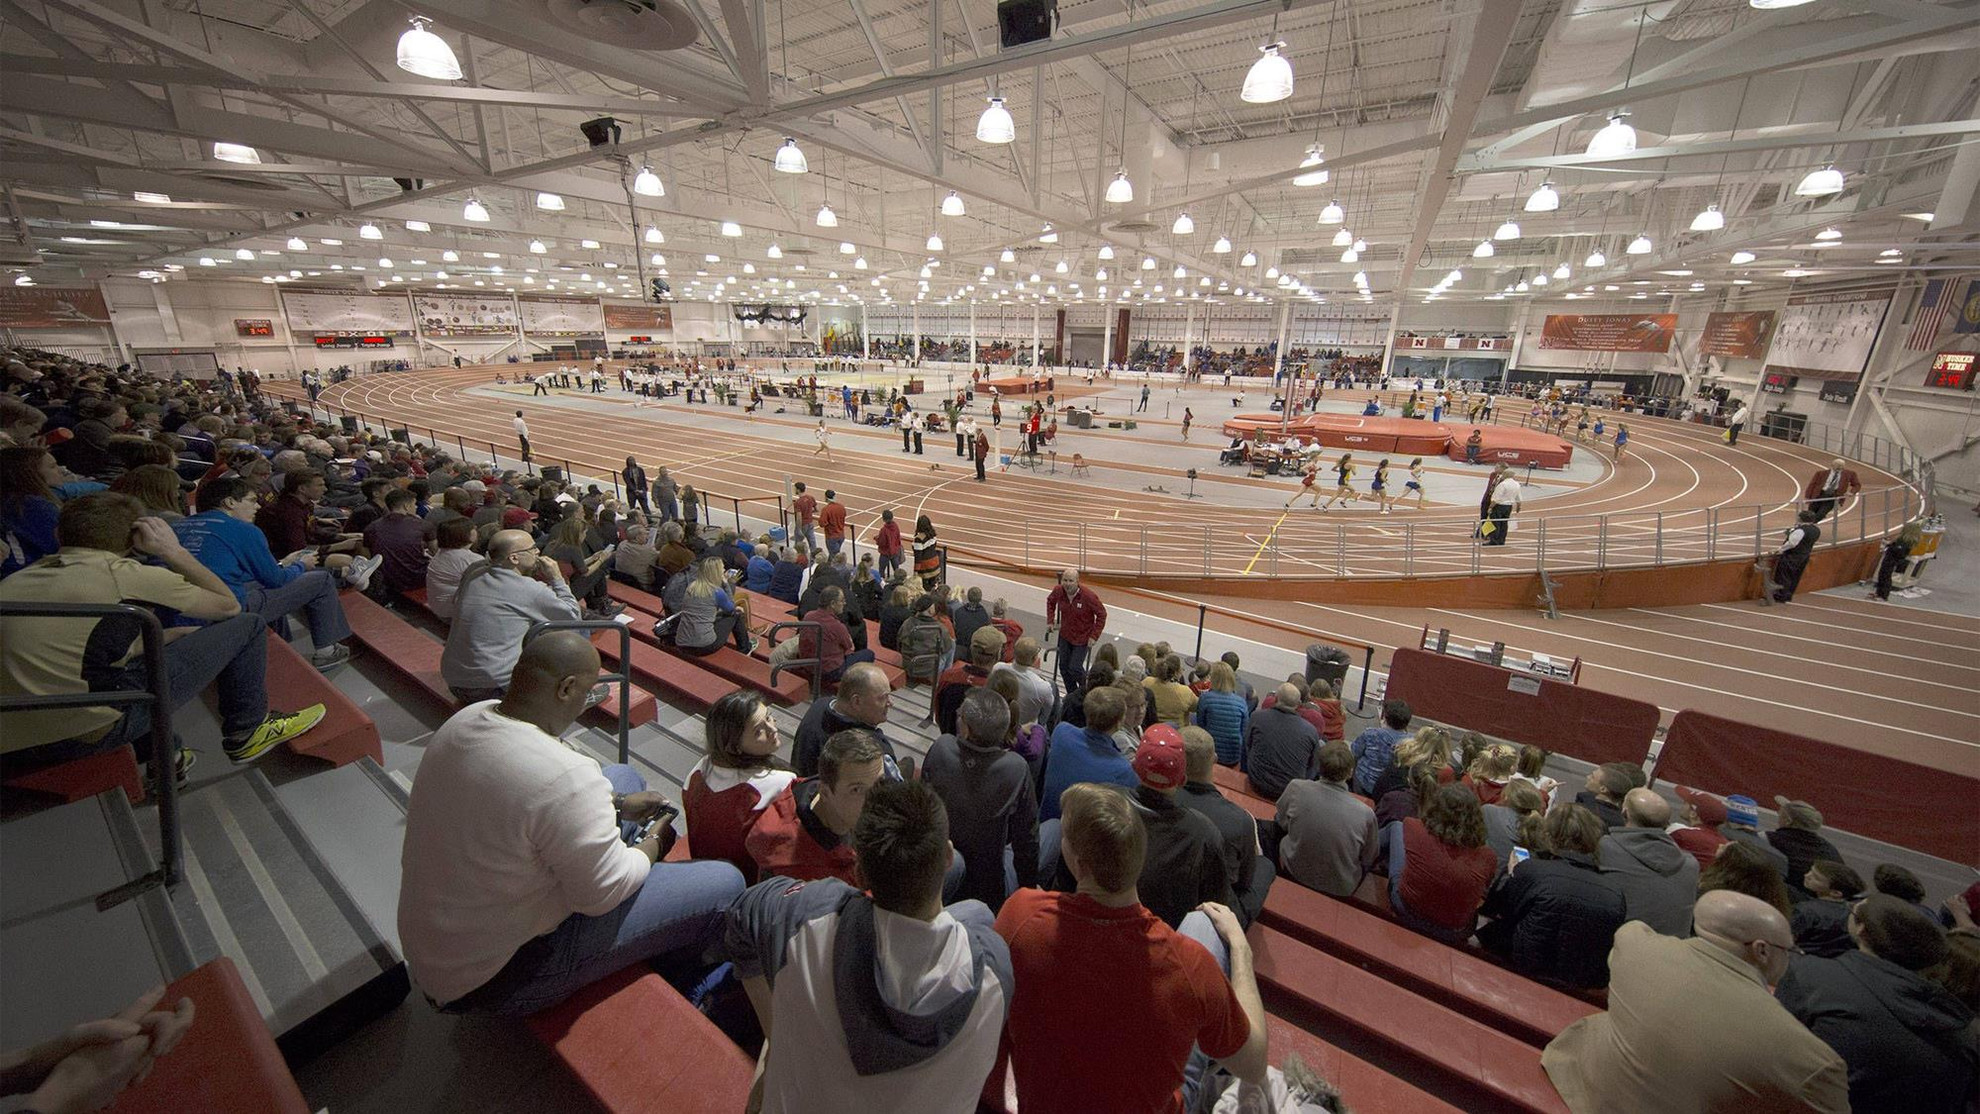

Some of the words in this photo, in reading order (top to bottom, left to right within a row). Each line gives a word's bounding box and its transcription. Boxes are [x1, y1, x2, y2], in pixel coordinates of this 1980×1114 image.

[1481, 340, 1492, 348] N
[1945, 354, 1975, 363] HUSKER
[1946, 362, 1967, 371] TIME
